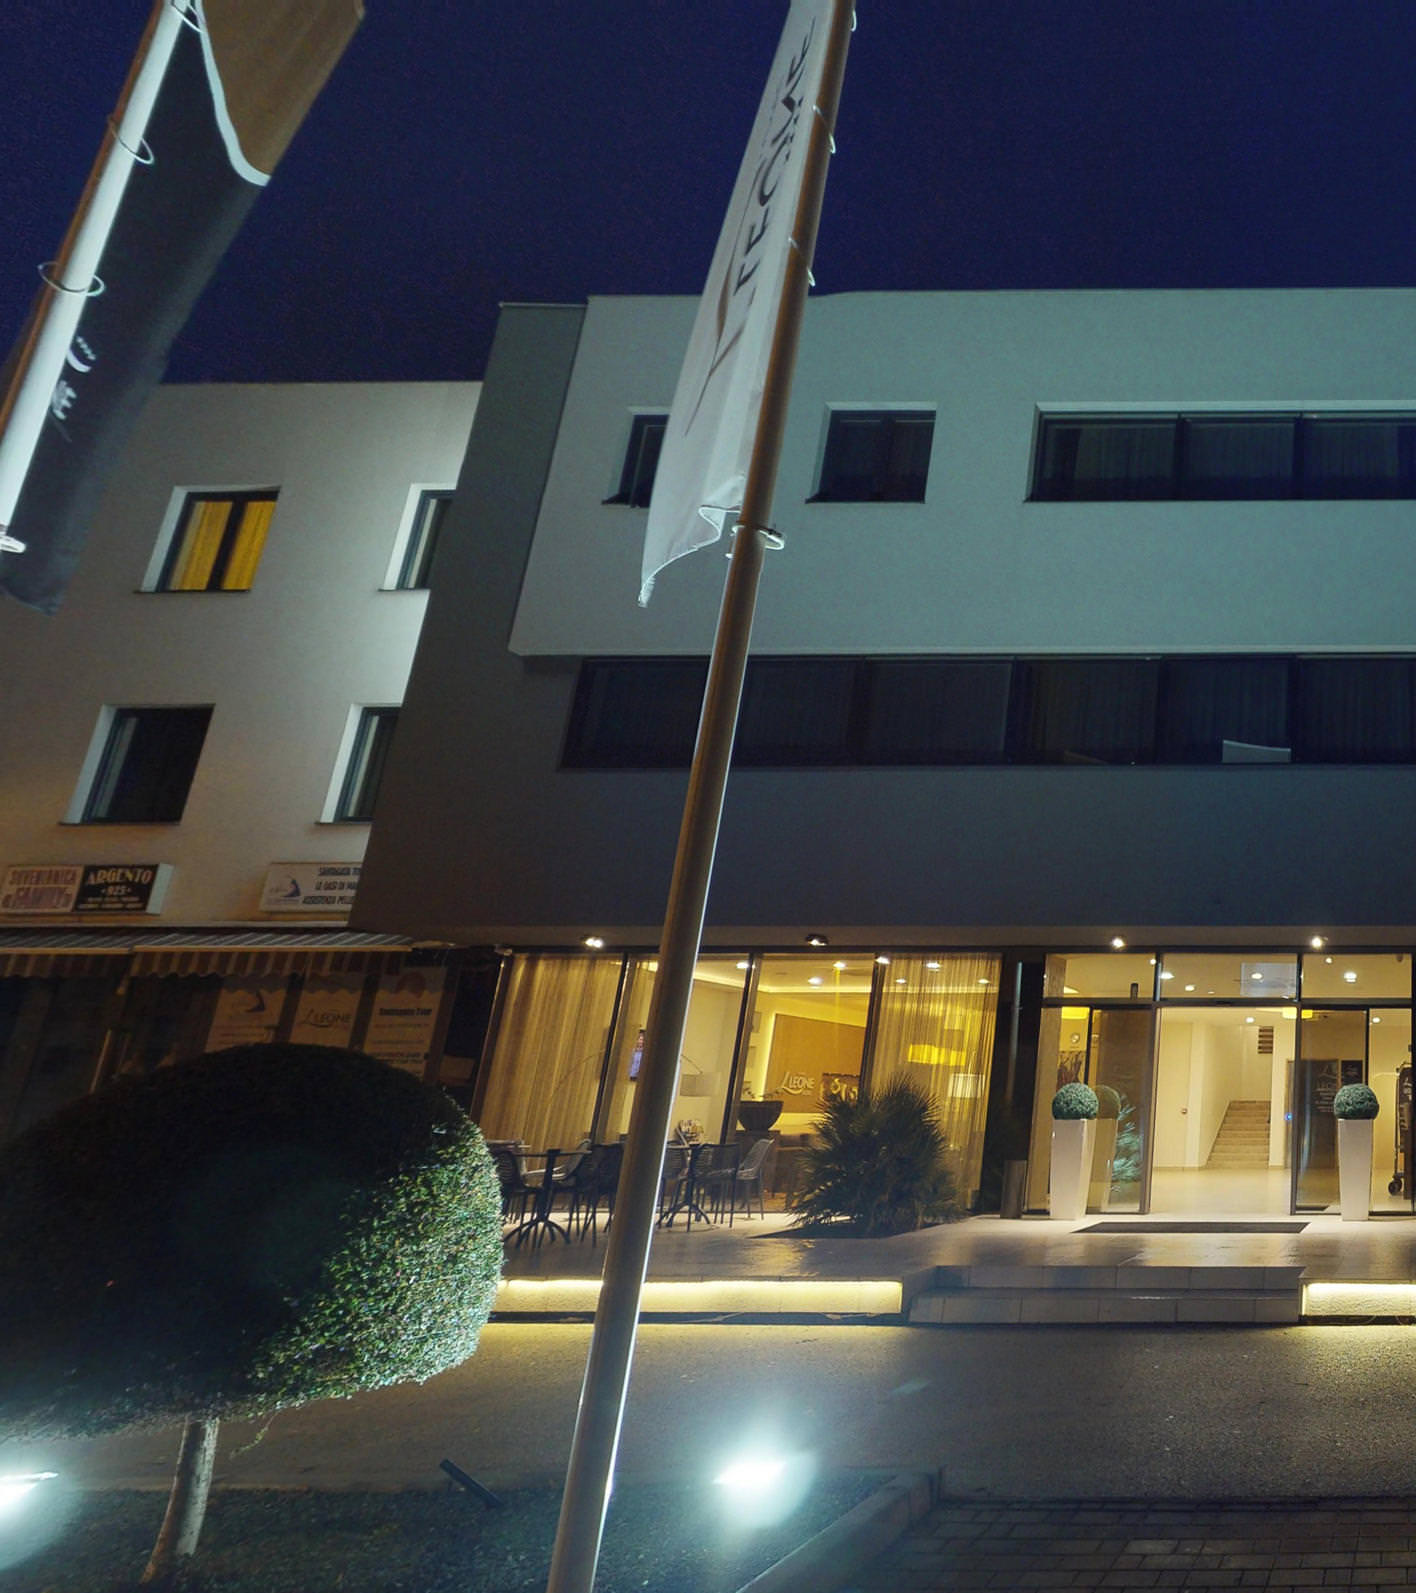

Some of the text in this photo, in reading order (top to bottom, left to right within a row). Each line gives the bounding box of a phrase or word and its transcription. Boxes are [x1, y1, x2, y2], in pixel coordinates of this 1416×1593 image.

[87, 867, 152, 886] ARGENTO
[318, 1013, 351, 1024] LEONE
[788, 1075, 816, 1090] LEONE
